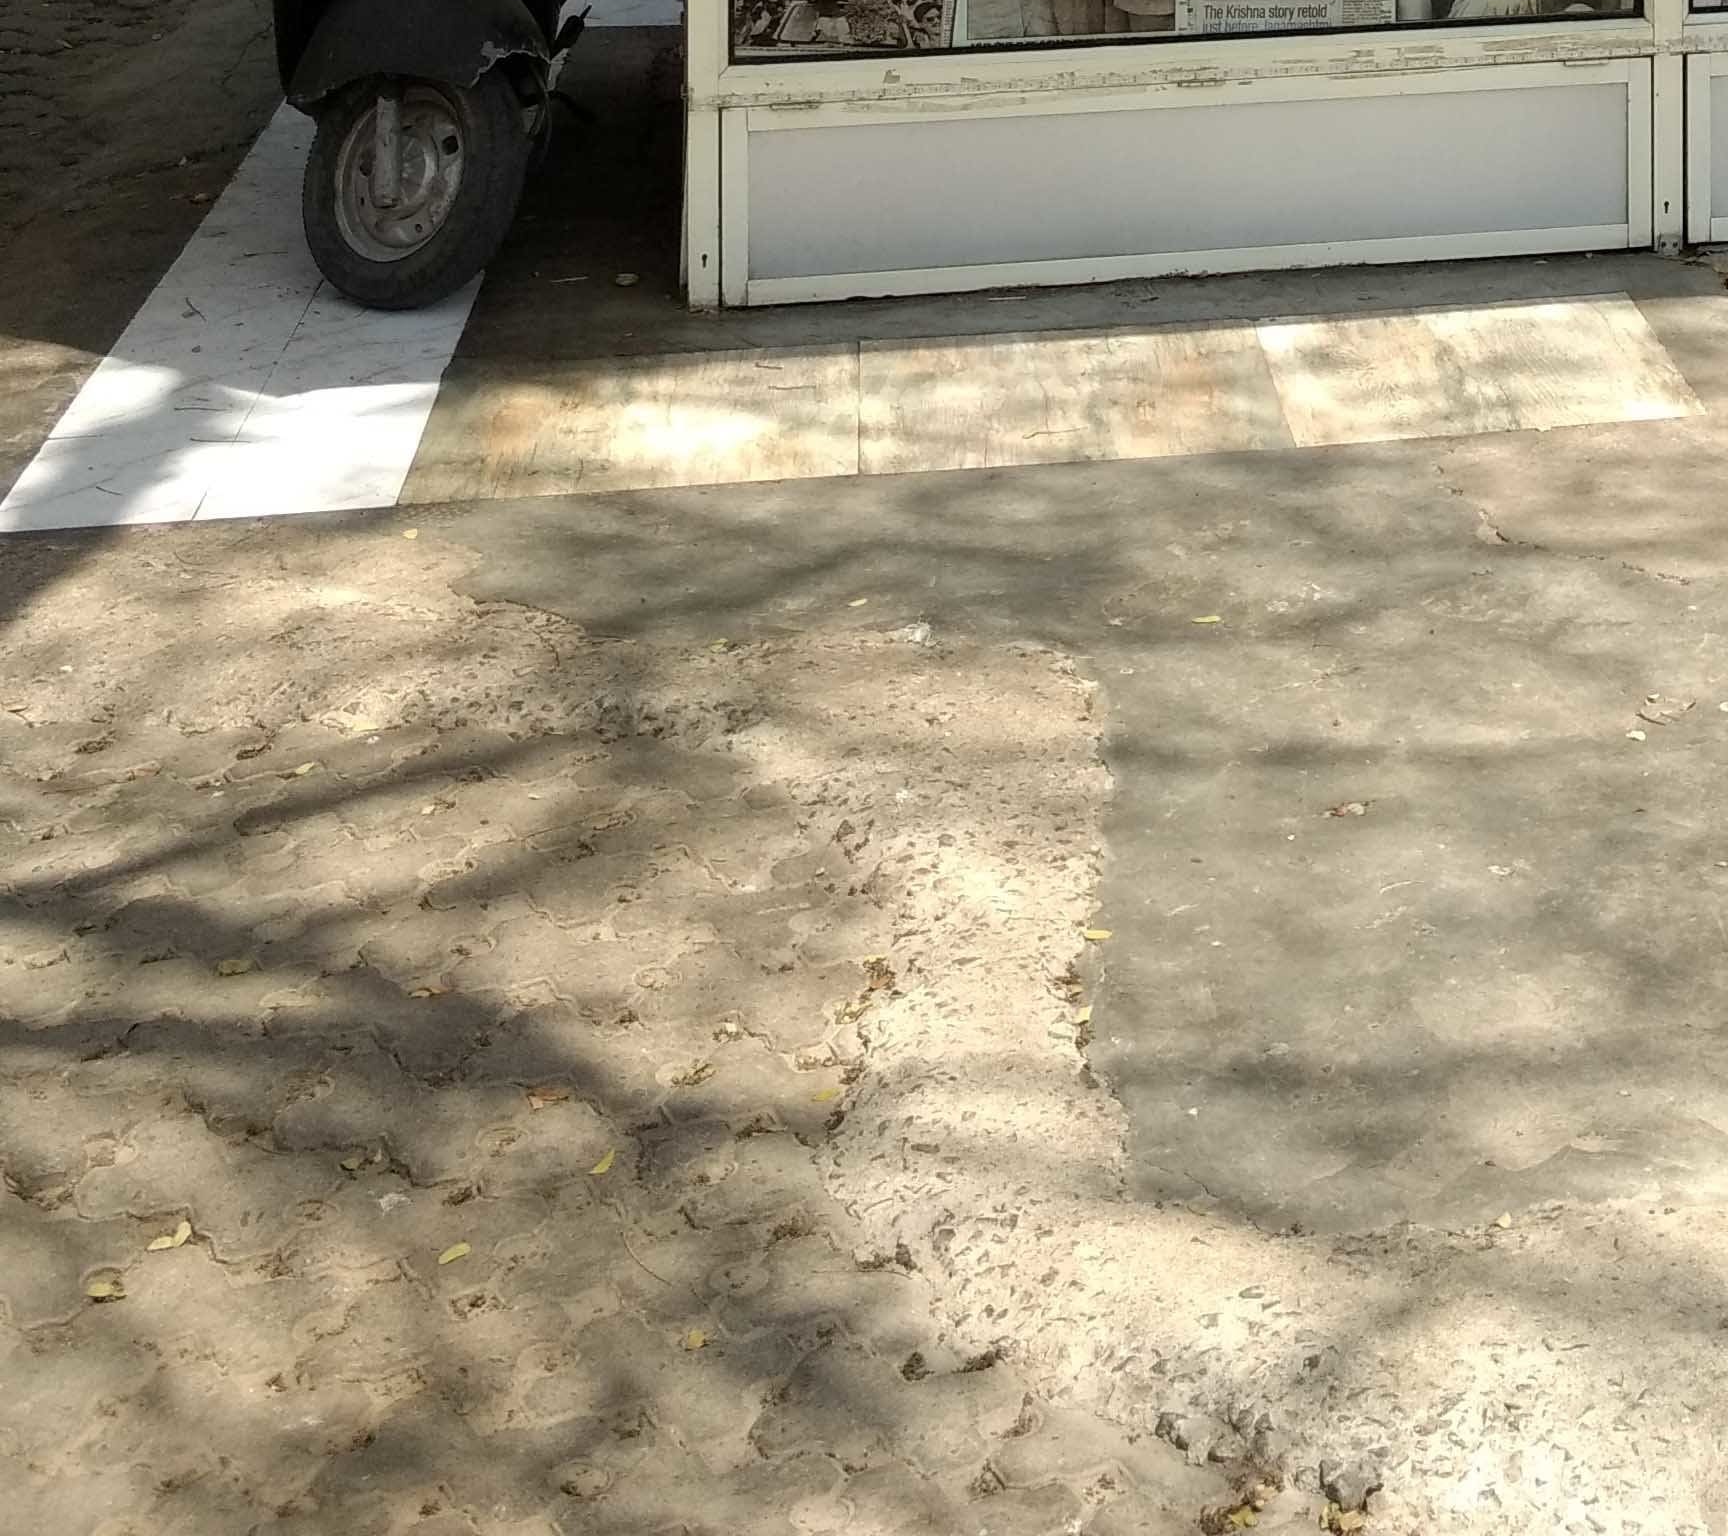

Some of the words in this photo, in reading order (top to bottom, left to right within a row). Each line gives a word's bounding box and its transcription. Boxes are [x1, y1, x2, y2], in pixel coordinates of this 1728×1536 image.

[1204, 4, 1223, 19] The
[1226, 4, 1266, 19] Krishna
[1268, 4, 1295, 21] story
[1297, 3, 1328, 18] retold
